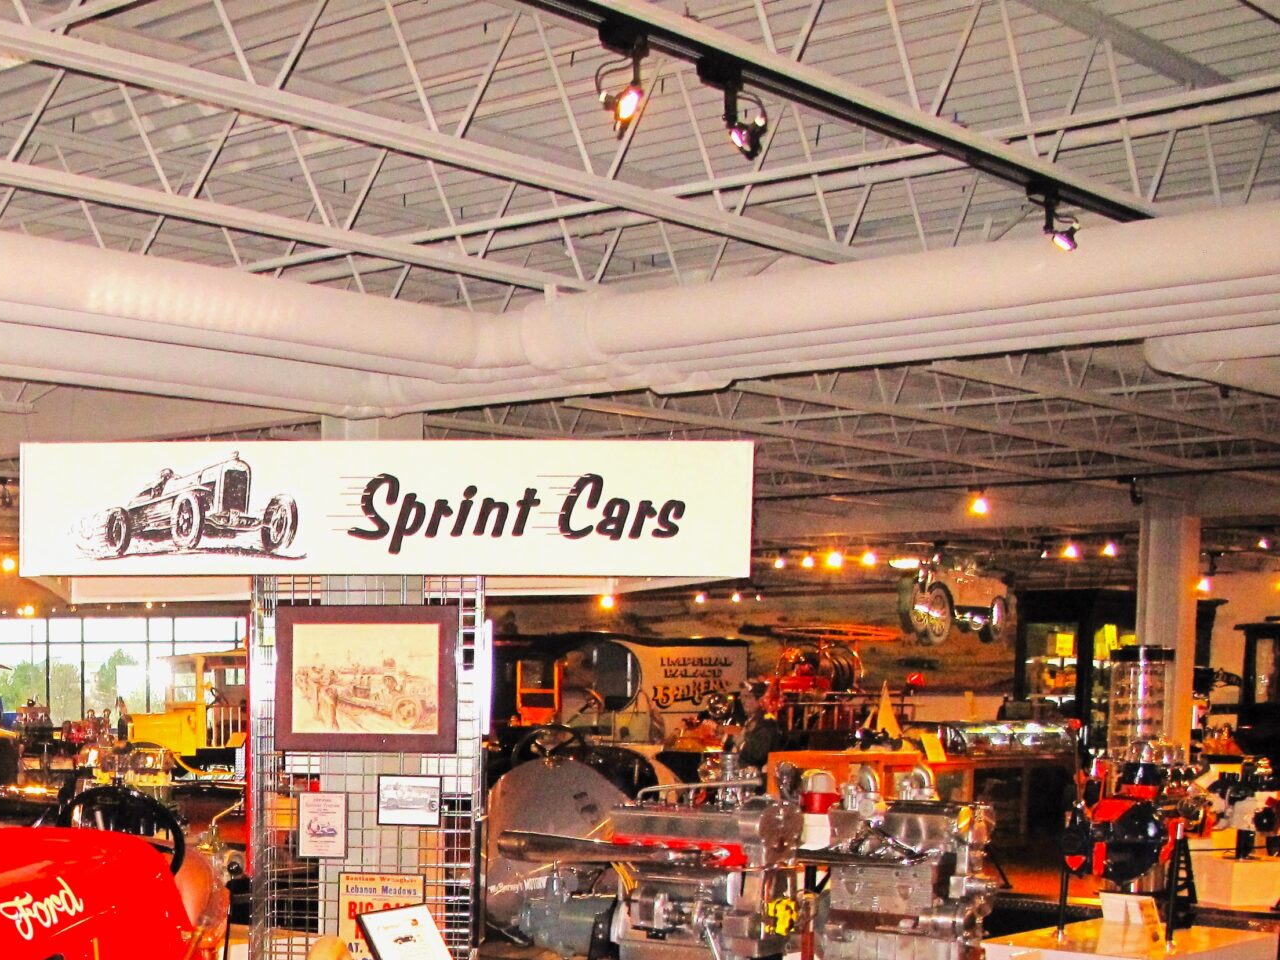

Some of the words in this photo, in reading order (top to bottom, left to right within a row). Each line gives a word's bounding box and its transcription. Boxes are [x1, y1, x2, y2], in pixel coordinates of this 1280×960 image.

[347, 473, 540, 554] Sprint
[558, 473, 686, 540] Cars
[346, 884, 377, 895] Lebanon
[381, 885, 418, 896] Meadows
